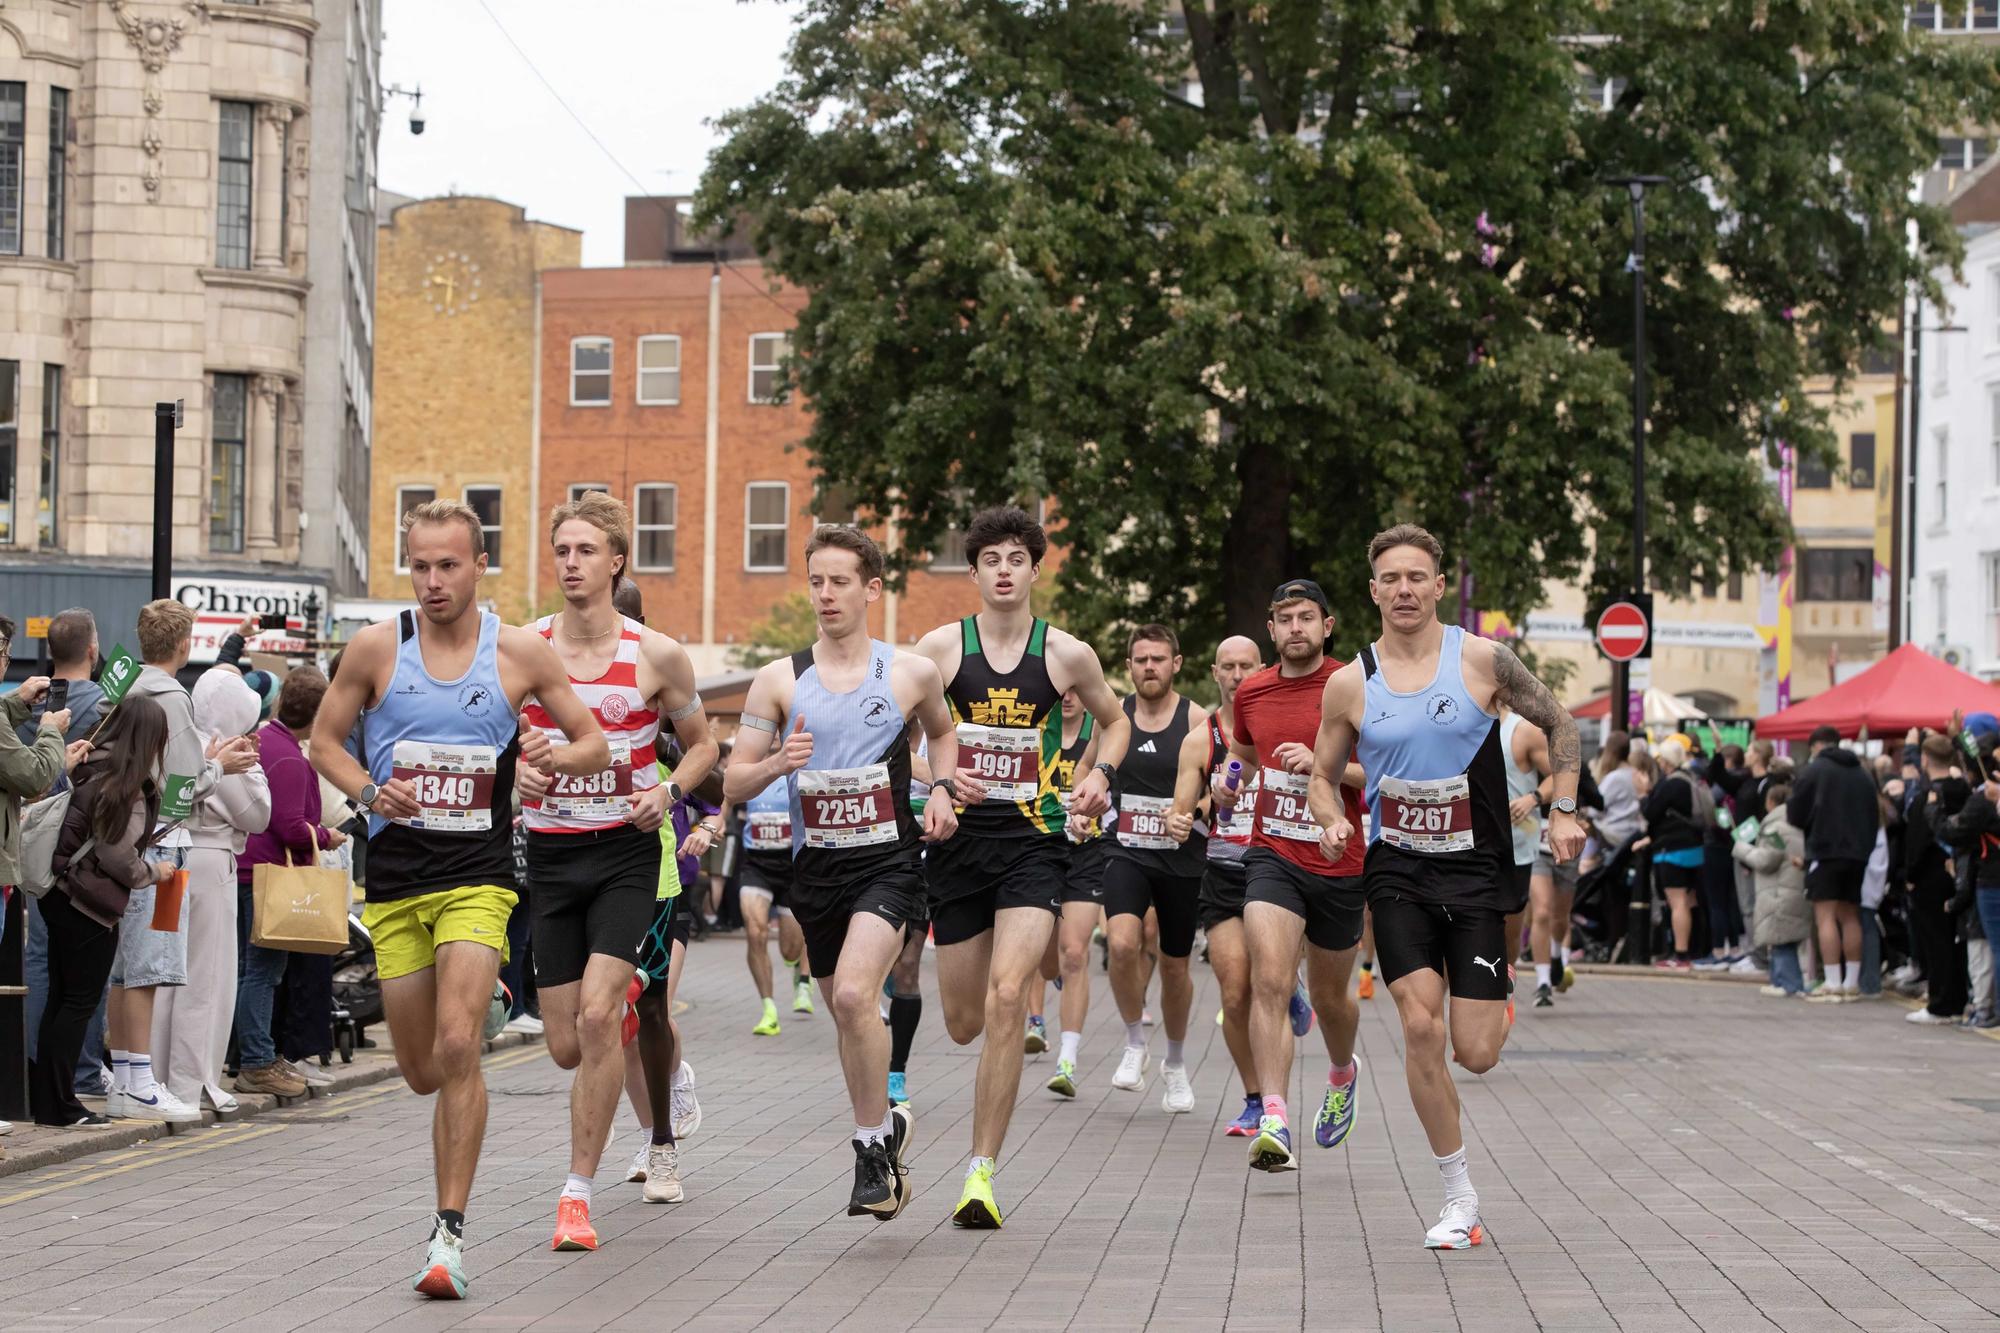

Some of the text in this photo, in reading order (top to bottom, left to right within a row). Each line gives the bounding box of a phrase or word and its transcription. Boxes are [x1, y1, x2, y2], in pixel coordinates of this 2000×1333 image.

[875, 657, 884, 680] soar
[972, 752, 1022, 779] 1991
[412, 774, 475, 806] 1349
[554, 769, 616, 794] 2338
[816, 795, 878, 825] 2254
[1397, 804, 1453, 831] 2267
[758, 826, 782, 839] 1781
